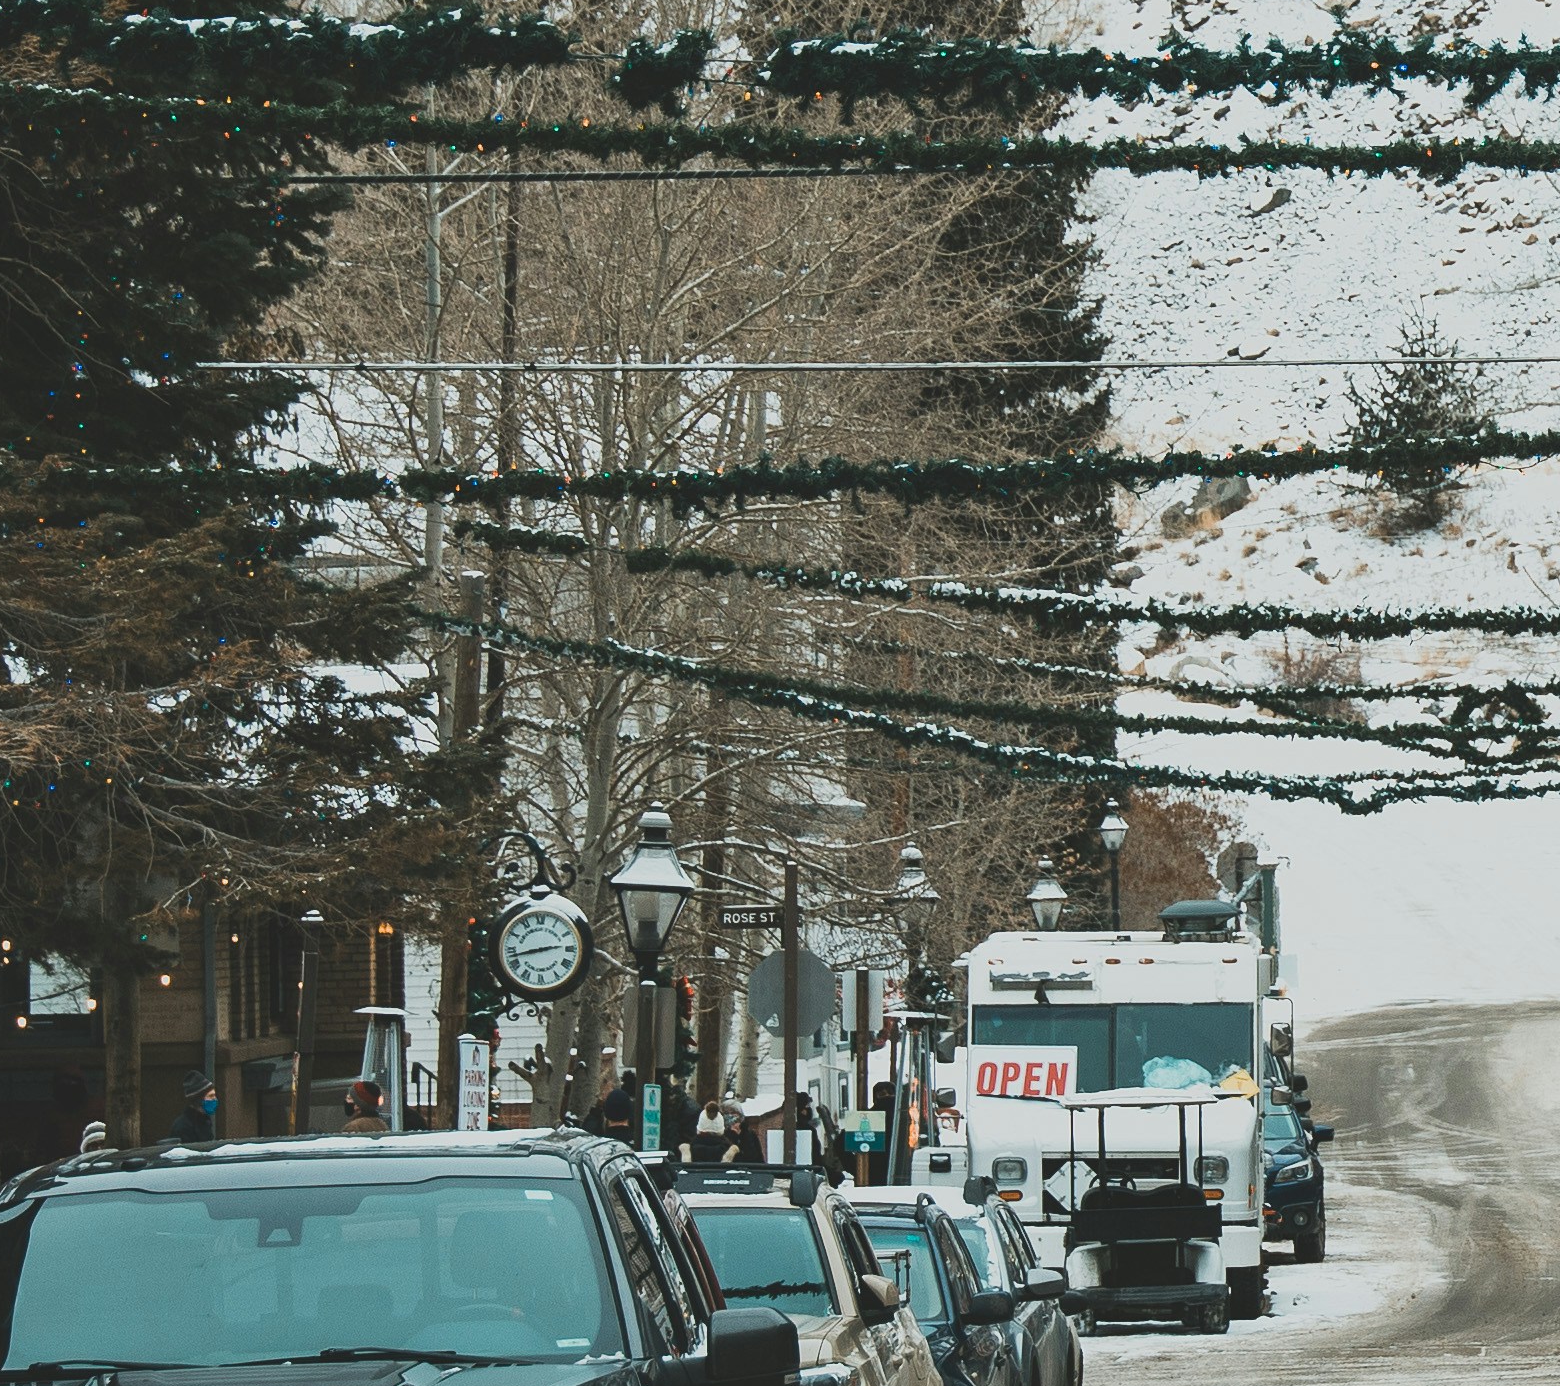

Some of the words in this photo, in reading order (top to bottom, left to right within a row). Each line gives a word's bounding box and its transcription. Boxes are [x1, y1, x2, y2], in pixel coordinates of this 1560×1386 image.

[722, 912, 758, 924] ROSE
[464, 1070, 486, 1086] PARKING
[976, 1061, 1069, 1096] OPEN
